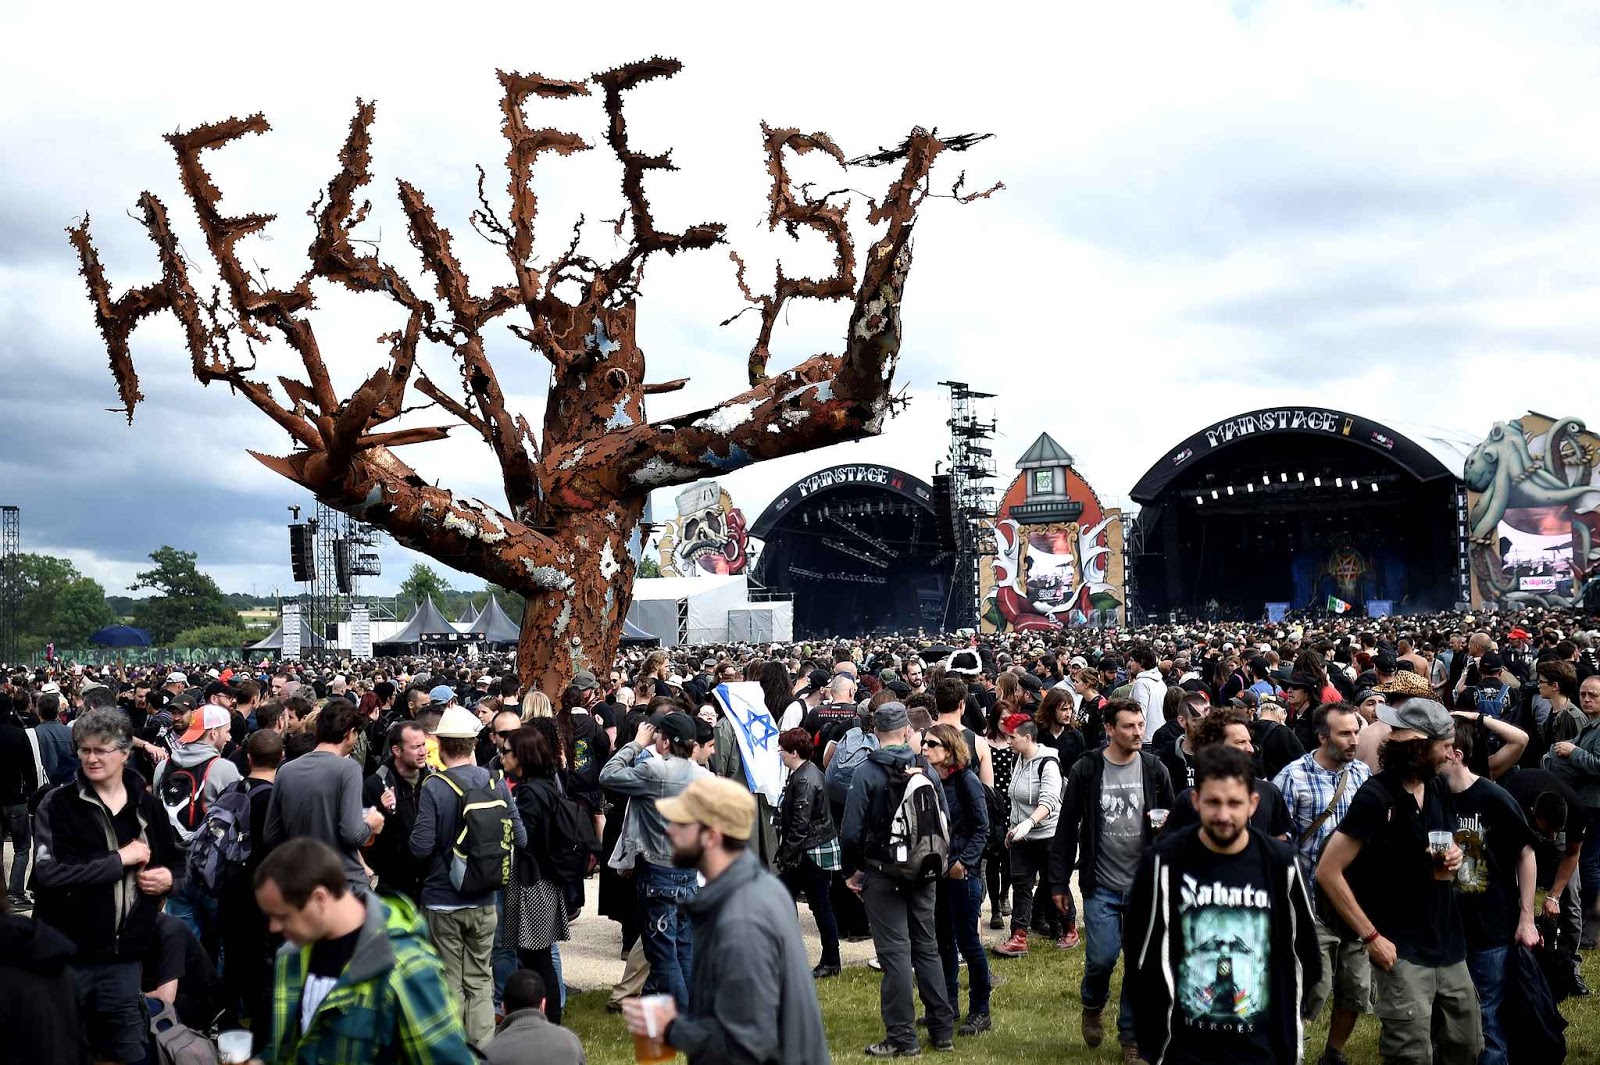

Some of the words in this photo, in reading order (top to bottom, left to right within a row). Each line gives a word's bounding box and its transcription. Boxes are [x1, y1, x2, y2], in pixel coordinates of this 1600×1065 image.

[1205, 410, 1339, 448] MAINSTAGE
[798, 466, 889, 497] MAINSTAGE
[1178, 873, 1271, 913] Sabato
[1184, 1016, 1255, 1034] HEROES
